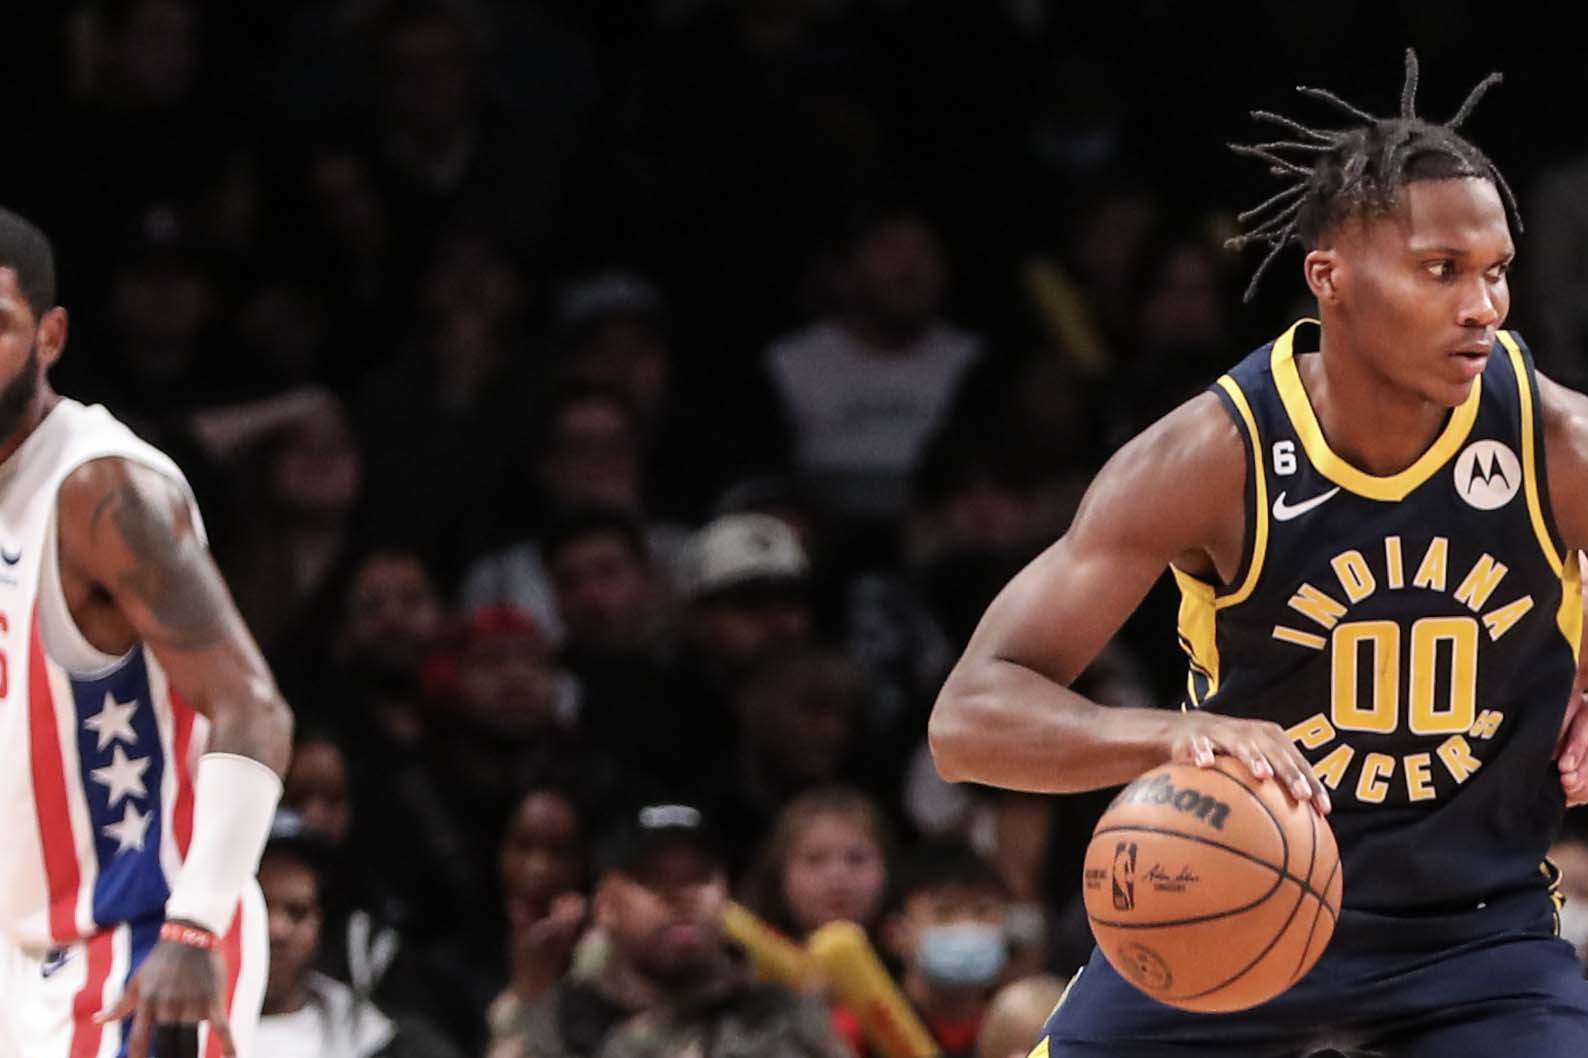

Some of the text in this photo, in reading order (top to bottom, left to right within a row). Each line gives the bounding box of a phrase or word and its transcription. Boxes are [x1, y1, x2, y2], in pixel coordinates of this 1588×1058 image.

[1272, 440, 1297, 476] 6
[1271, 536, 1534, 651] INDIANA
[1331, 616, 1479, 736] 00
[1284, 709, 1504, 804] PACERS
